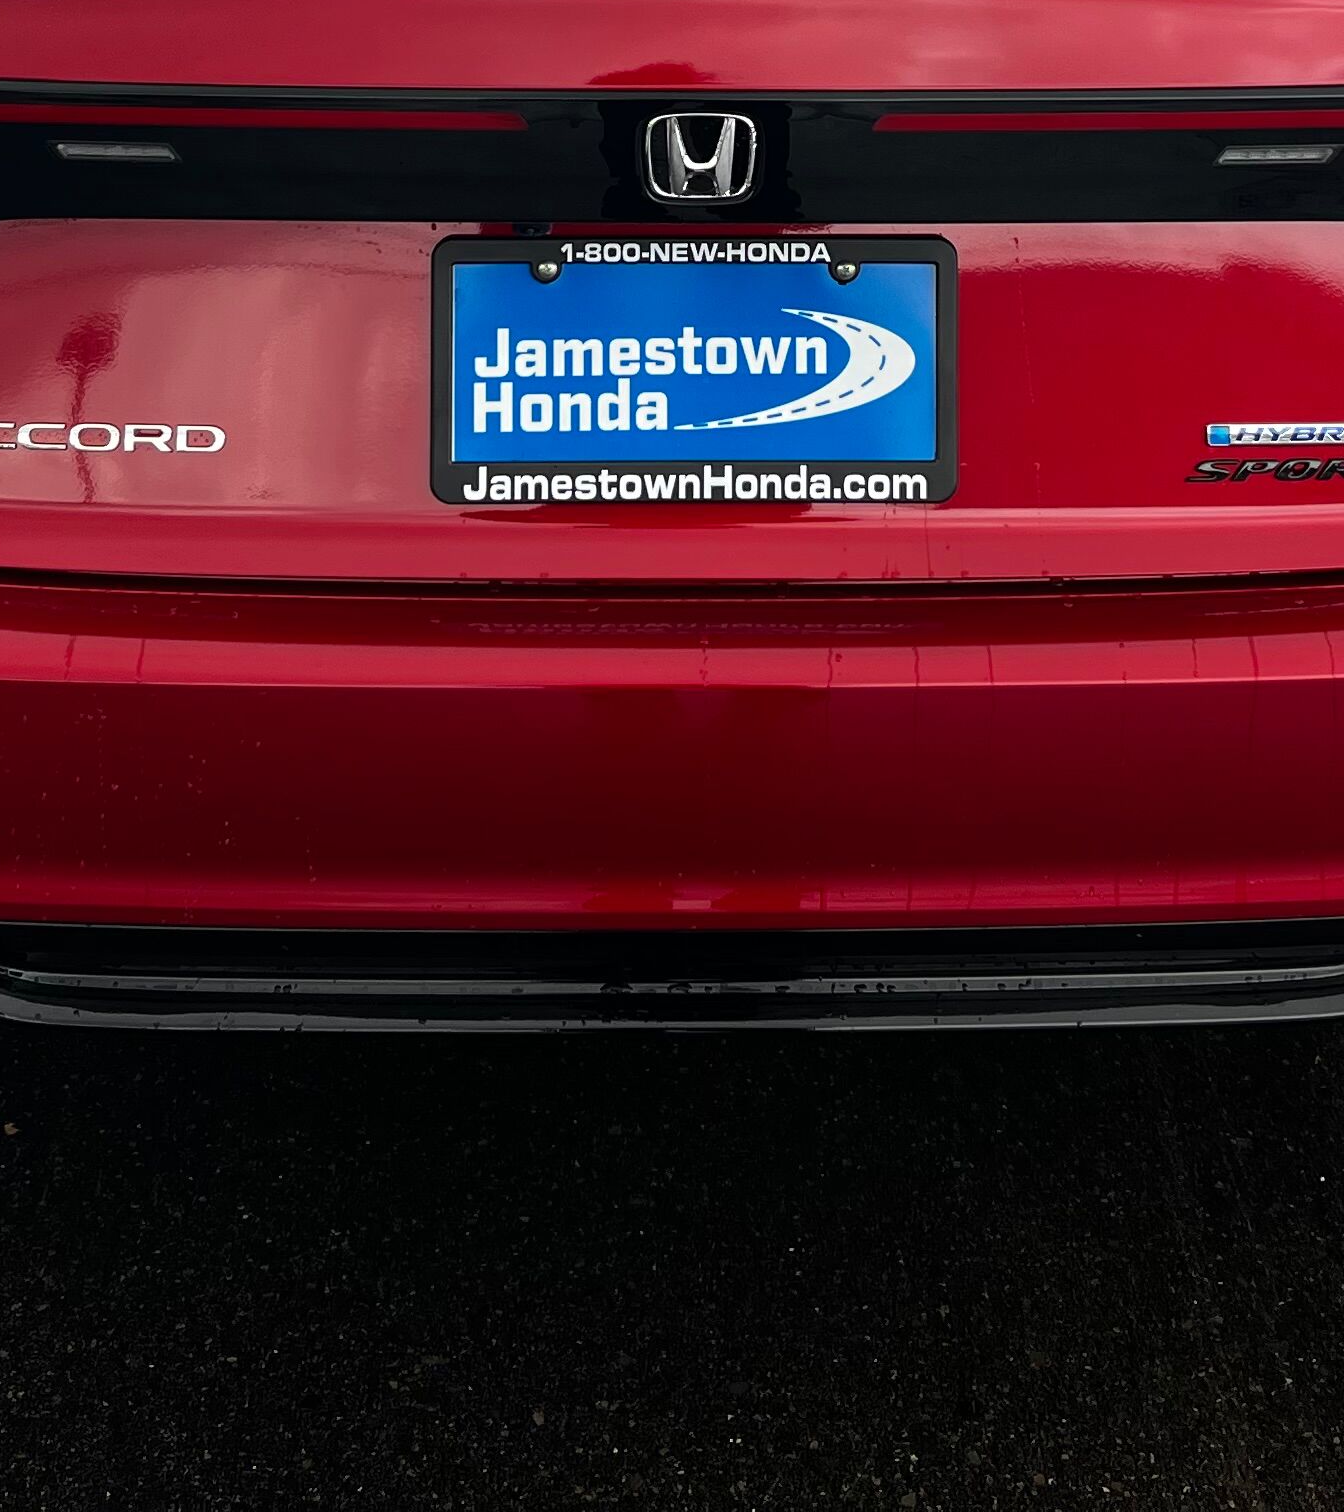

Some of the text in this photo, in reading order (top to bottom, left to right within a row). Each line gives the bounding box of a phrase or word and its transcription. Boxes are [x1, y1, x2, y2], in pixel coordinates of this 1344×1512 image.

[560, 242, 832, 264] 1-800-NEW-HONDA
[473, 326, 828, 379] Jamestown
[472, 378, 669, 433] Honda
[462, 464, 928, 502] JamestownHonda.com
